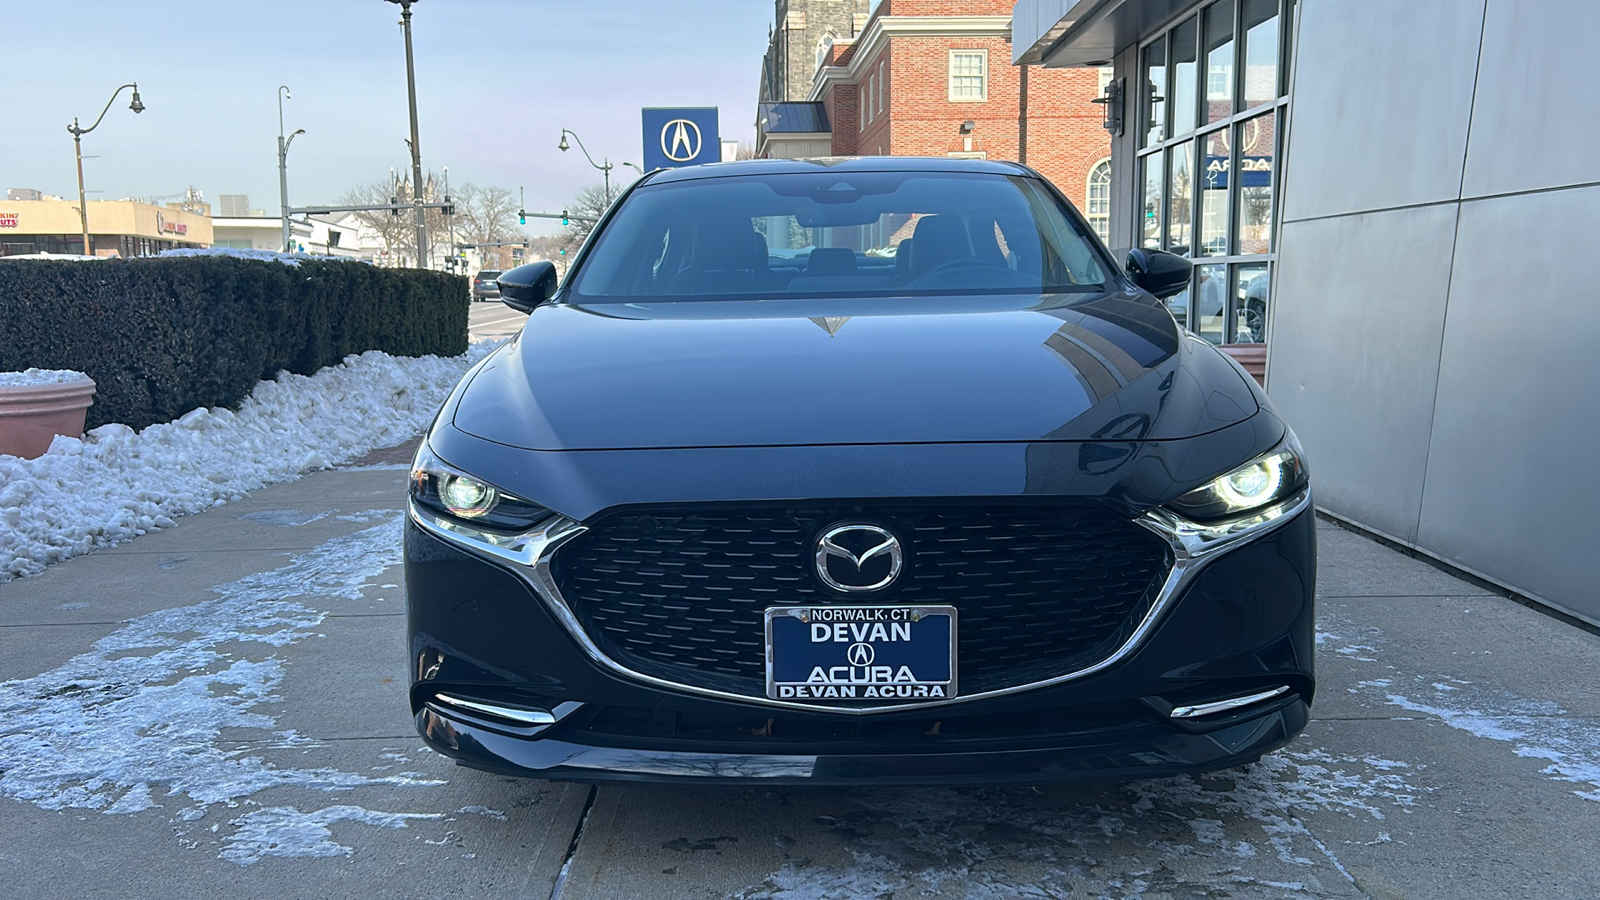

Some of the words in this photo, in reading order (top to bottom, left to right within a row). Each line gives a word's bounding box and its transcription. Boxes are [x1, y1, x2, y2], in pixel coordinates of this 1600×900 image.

[812, 609, 888, 620] NORWALK,
[890, 608, 910, 620] CT
[811, 622, 911, 642] DEVAN
[806, 665, 917, 683] ACURA
[779, 685, 856, 698] DEVAN
[863, 685, 945, 698] ACURA
